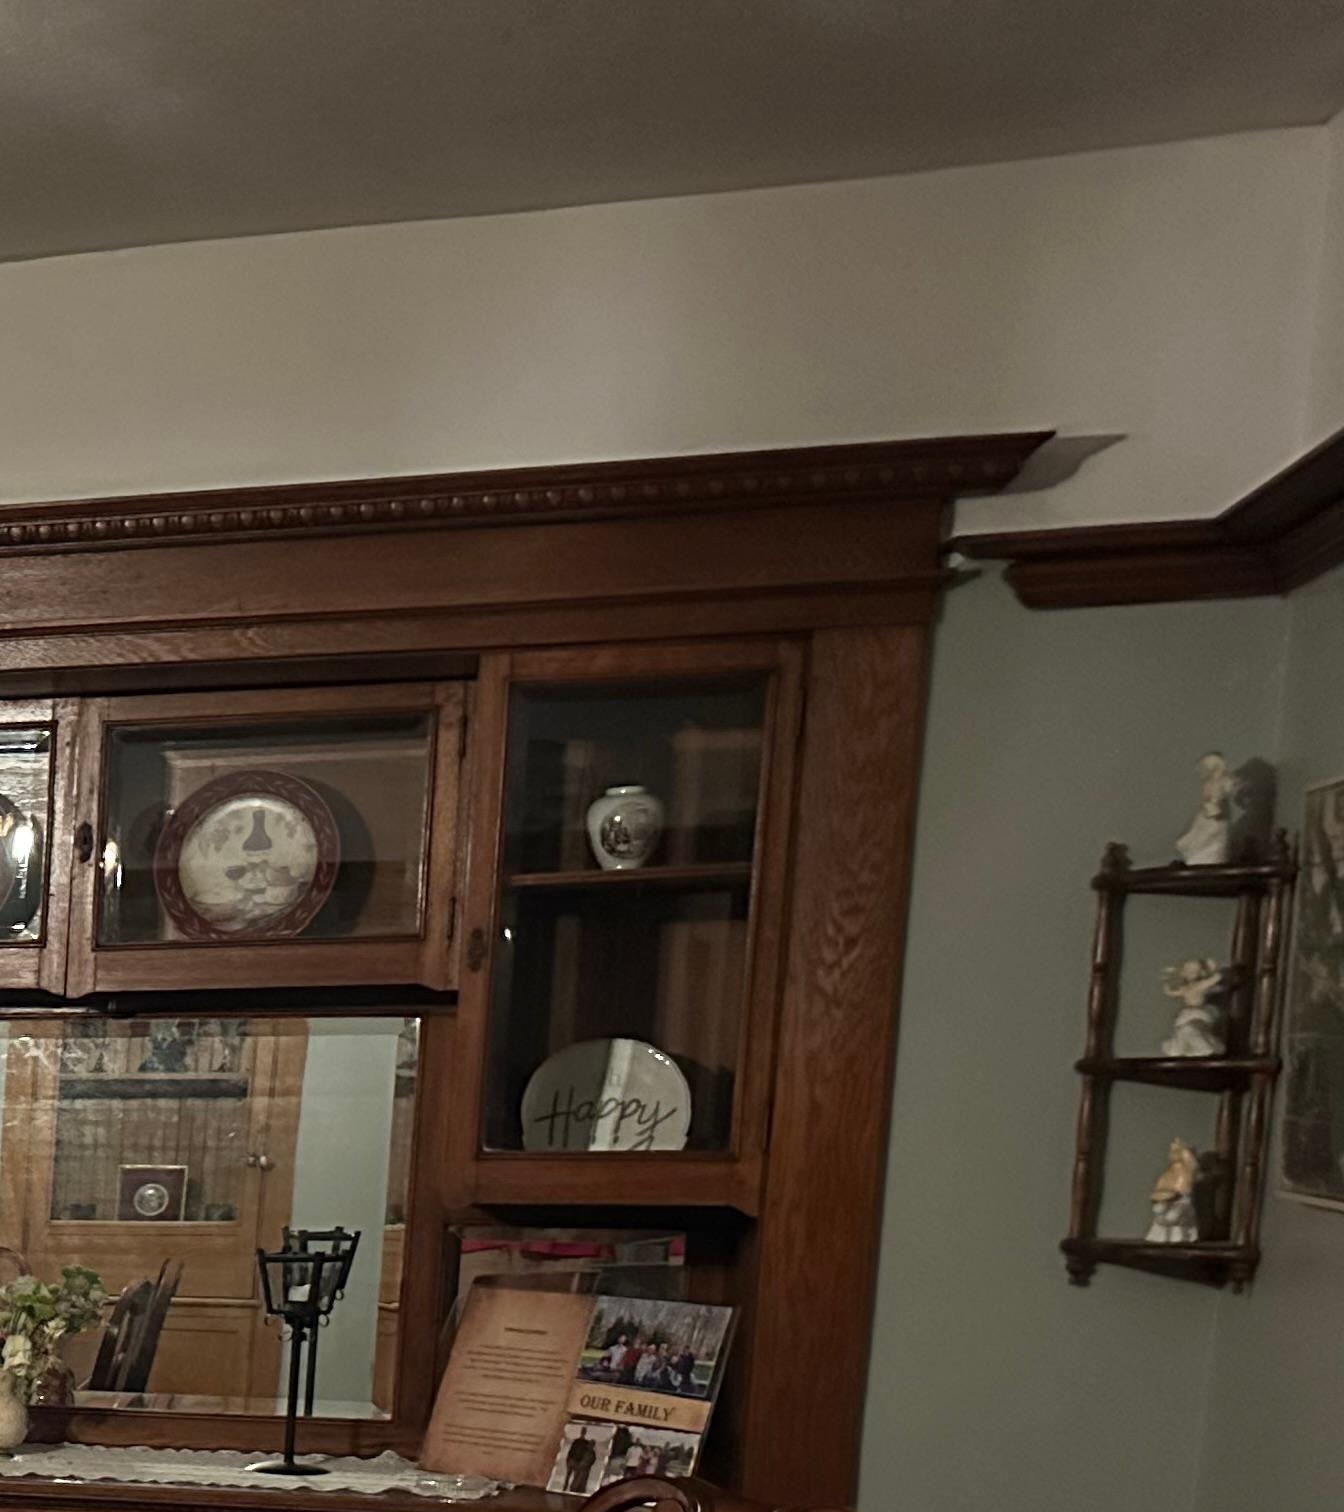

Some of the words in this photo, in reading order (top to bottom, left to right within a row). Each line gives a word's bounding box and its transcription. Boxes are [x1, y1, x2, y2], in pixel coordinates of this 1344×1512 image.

[534, 1086, 677, 1150] Happy
[580, 1394, 611, 1413] OUR
[614, 1399, 677, 1421] FAMILY
